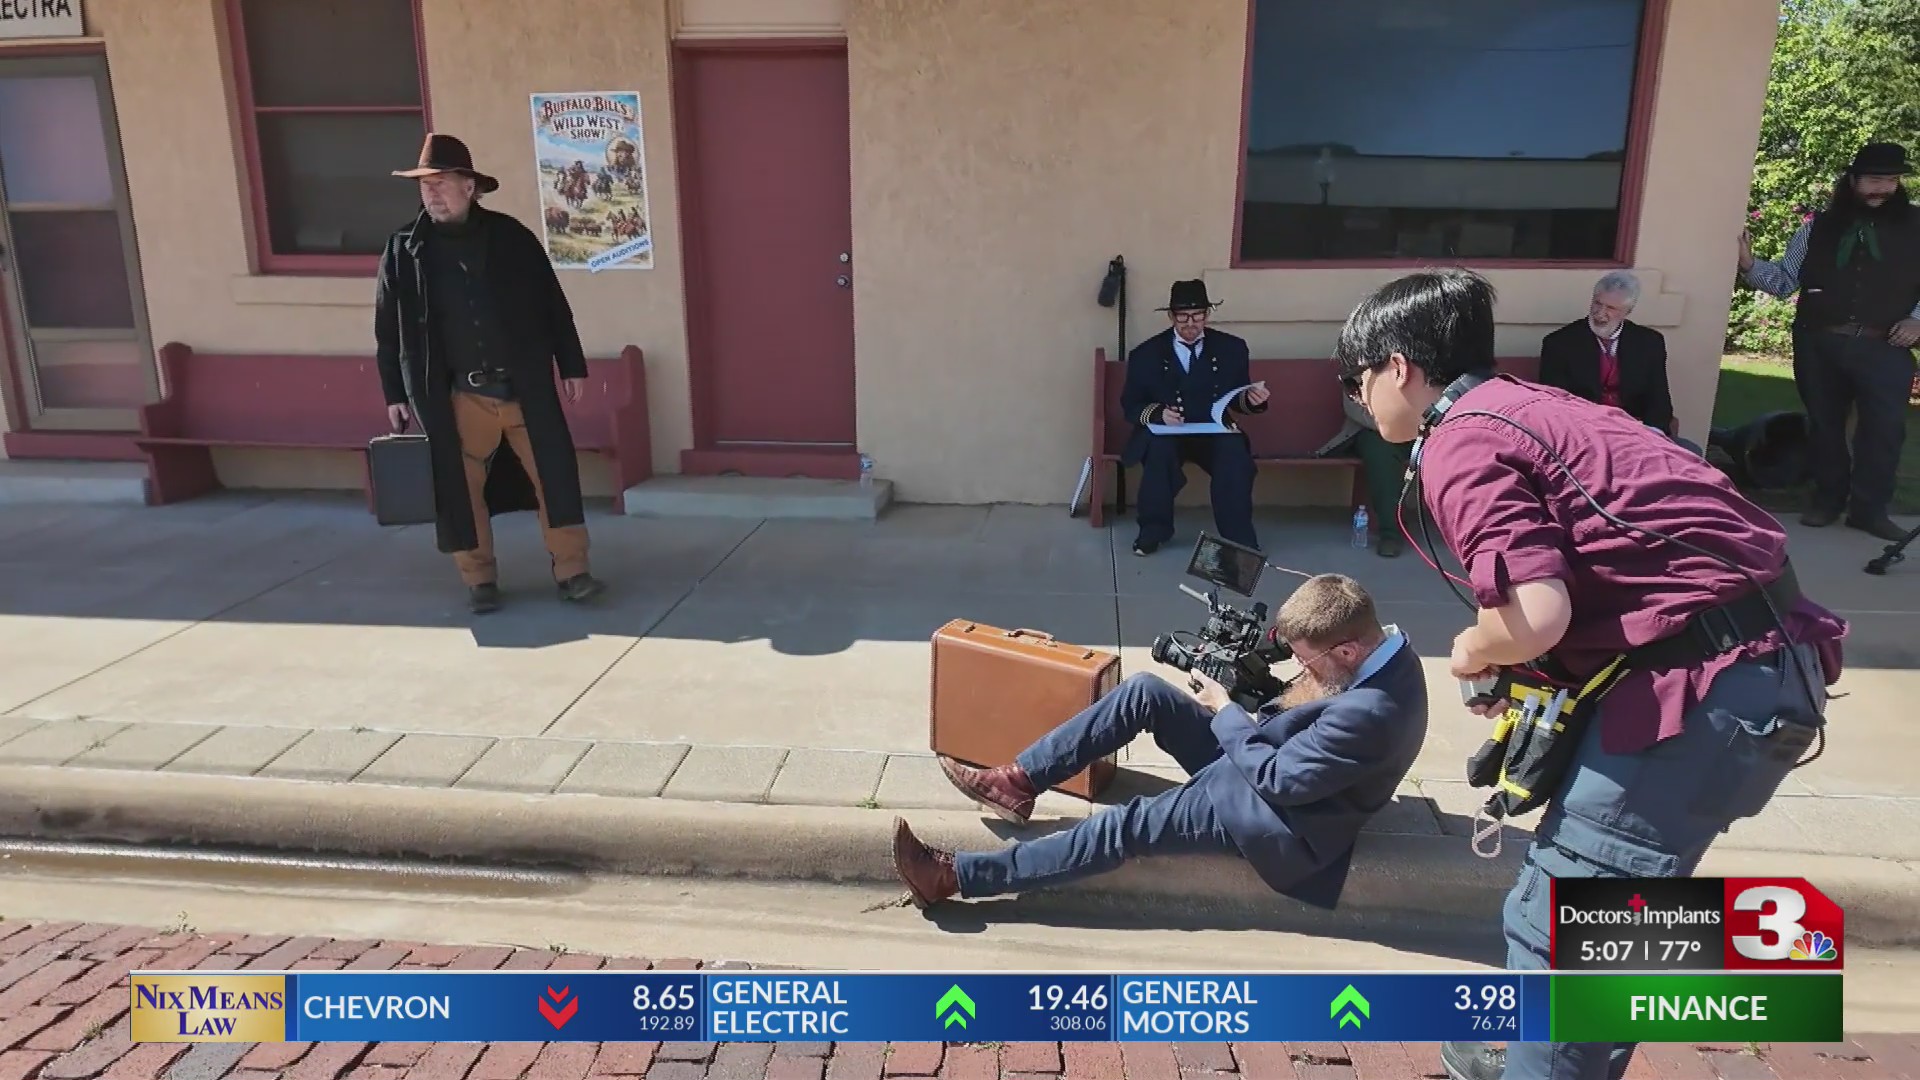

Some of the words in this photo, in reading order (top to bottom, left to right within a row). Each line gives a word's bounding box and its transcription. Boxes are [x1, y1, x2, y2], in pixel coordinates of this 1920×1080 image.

[0, 0, 72, 19] ECTRA
[543, 99, 592, 118] BUFFALO
[593, 96, 628, 116] BILL'S
[553, 116, 585, 132] WILD
[570, 128, 606, 140] SHOW!
[591, 256, 611, 268] OPEN
[612, 239, 650, 260] AUDITIONS
